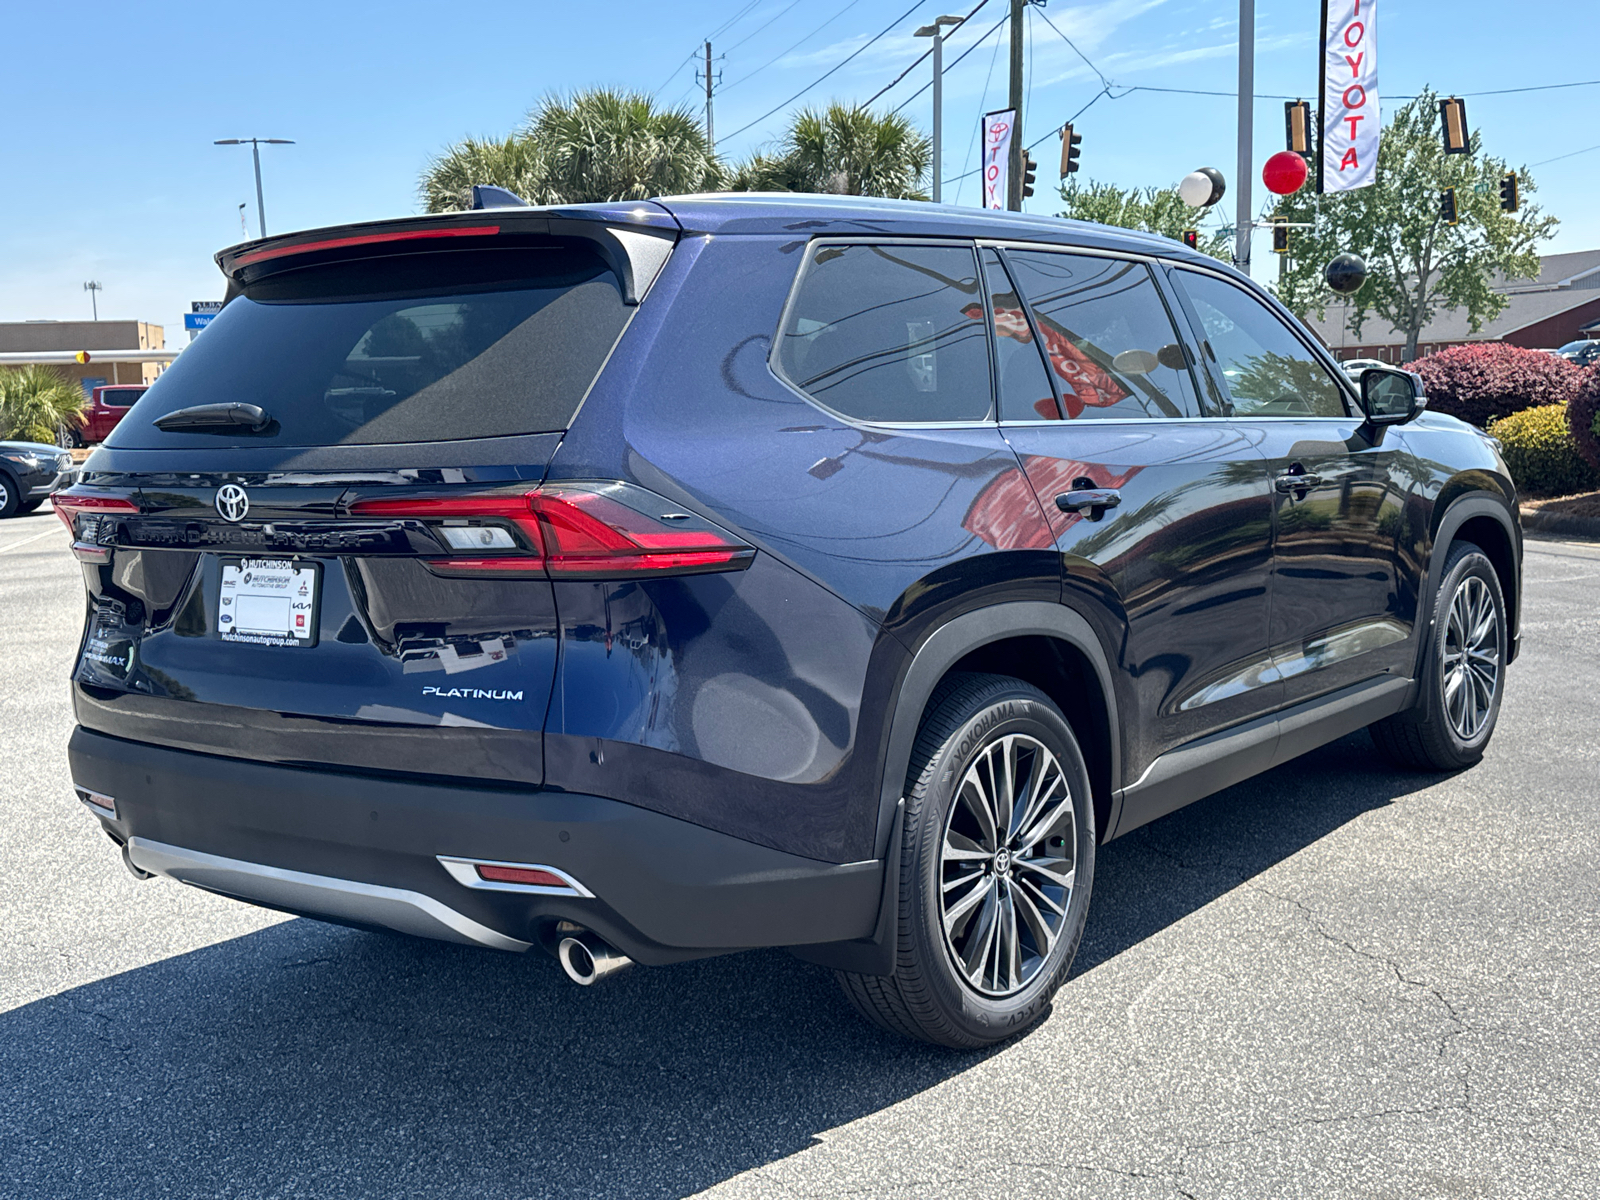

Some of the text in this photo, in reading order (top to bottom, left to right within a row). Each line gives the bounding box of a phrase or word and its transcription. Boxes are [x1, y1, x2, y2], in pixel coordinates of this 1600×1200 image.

[194, 317, 211, 325] Wal
[249, 560, 293, 570] HUTCHINSON
[222, 632, 299, 646] Hutchinsonautogroup.com
[422, 686, 523, 701] PLATINUM
[954, 702, 1015, 761] YOKOHAMA
